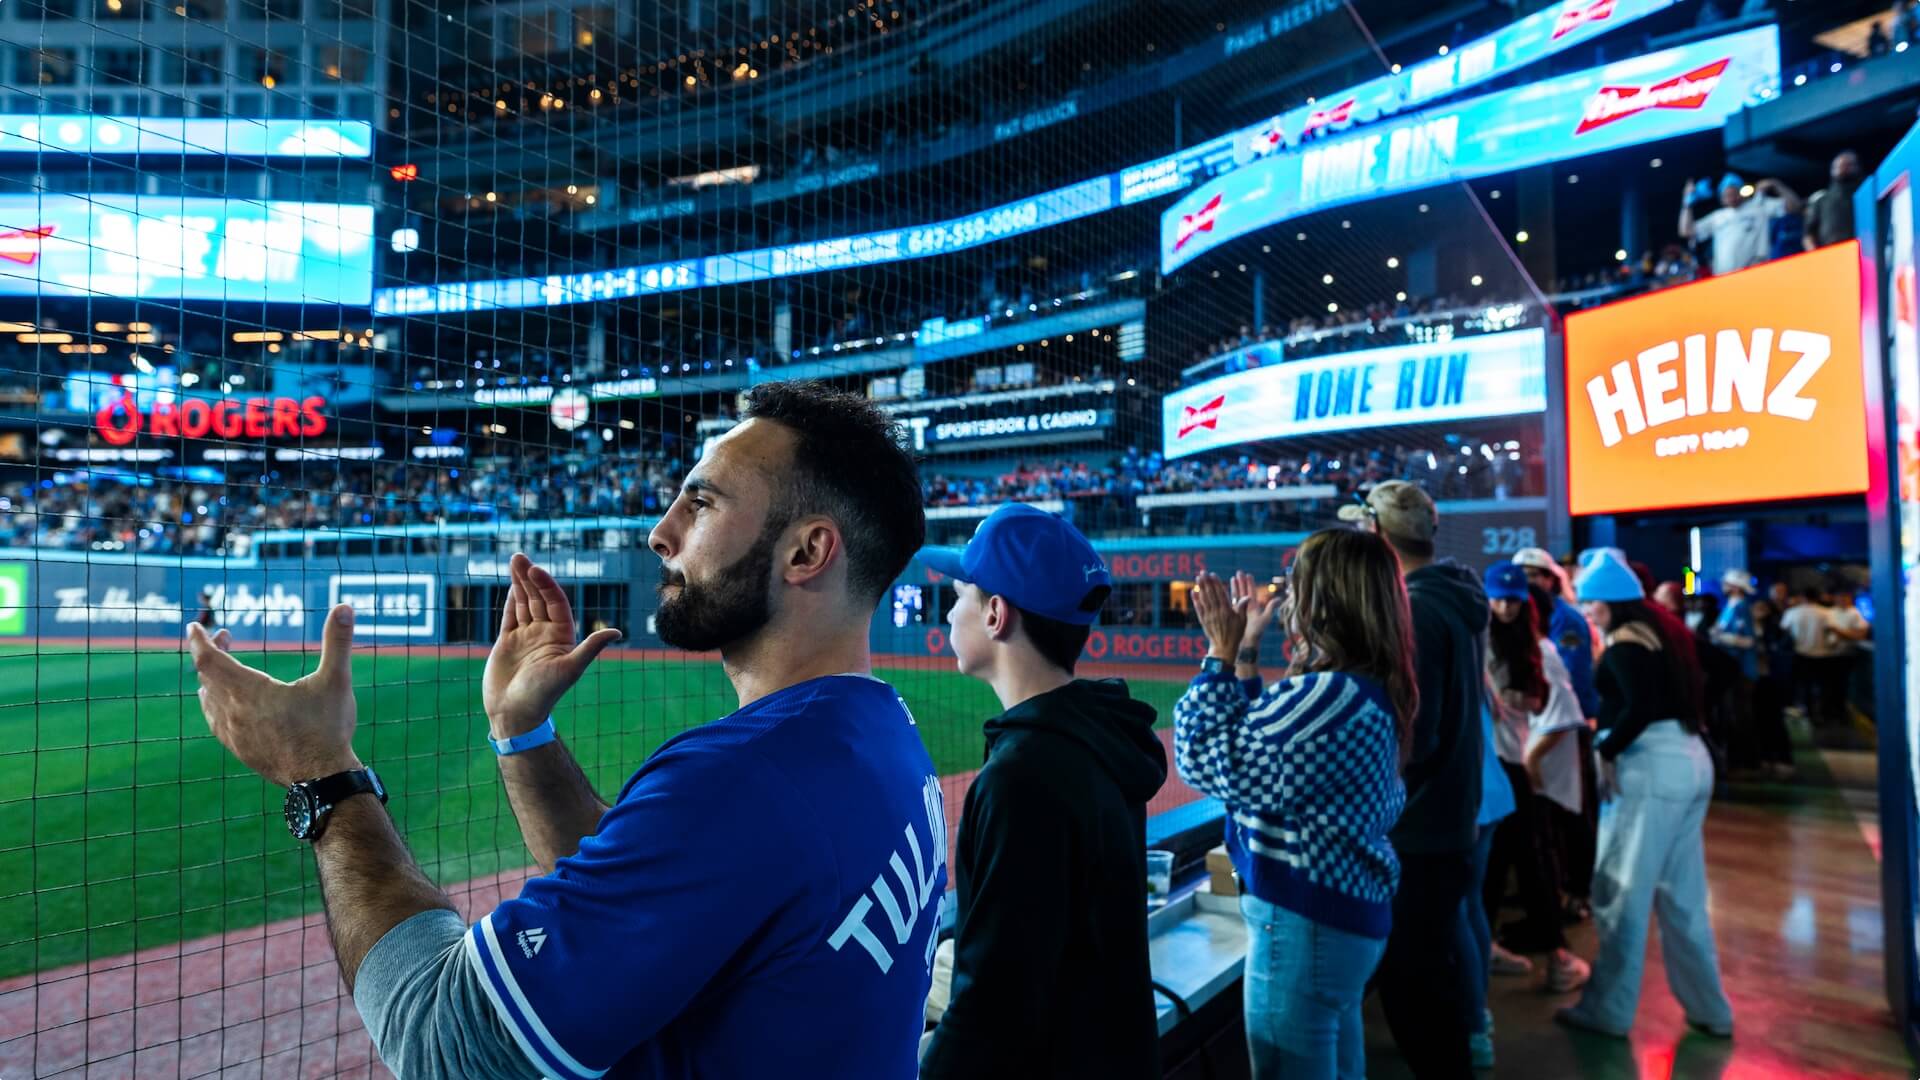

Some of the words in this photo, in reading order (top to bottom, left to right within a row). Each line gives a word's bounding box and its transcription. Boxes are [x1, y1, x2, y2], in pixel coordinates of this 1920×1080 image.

[1294, 363, 1377, 421] HOME
[1395, 353, 1468, 410] RUN
[1586, 328, 1831, 447] HEINZ
[149, 395, 327, 438] ROGERS
[936, 417, 1026, 439] SPORTSBOOK
[1027, 415, 1039, 430] &
[1040, 409, 1097, 429] CASINO
[1482, 527, 1537, 554] 328
[1112, 554, 1207, 577] ROGERS
[1112, 634, 1207, 658] ROGERS
